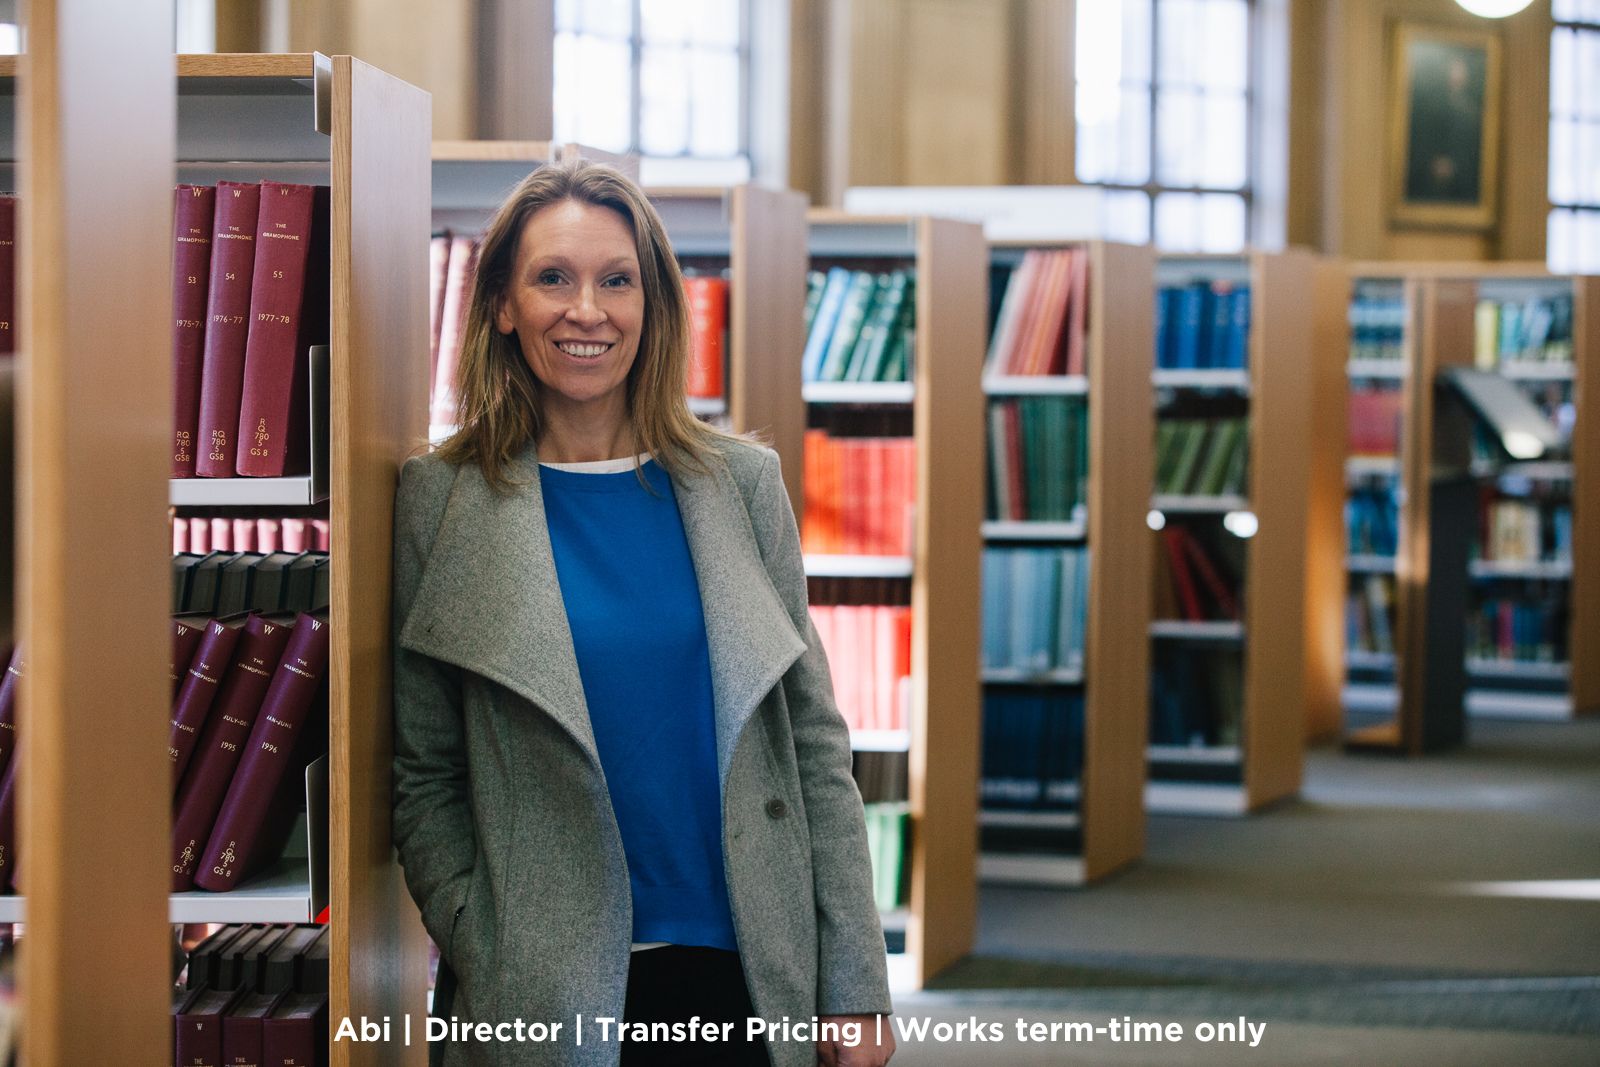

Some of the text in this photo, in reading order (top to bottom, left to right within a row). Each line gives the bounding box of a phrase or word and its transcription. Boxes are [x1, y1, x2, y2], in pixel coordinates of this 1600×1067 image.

[192, 188, 202, 197] W
[263, 233, 300, 241] GRAMOPHONE
[213, 315, 243, 324] 1976-77
[258, 314, 290, 324] 1977-78
[254, 432, 269, 440] 780
[177, 625, 188, 636] W
[214, 623, 224, 635] W
[264, 624, 274, 636] W
[312, 620, 322, 631] W
[200, 662, 210, 670] THE
[297, 658, 308, 667] THE
[266, 715, 292, 729] JAN-JUNE
[221, 741, 236, 752] 1995
[261, 741, 278, 754] 1996
[220, 852, 235, 863] 780
